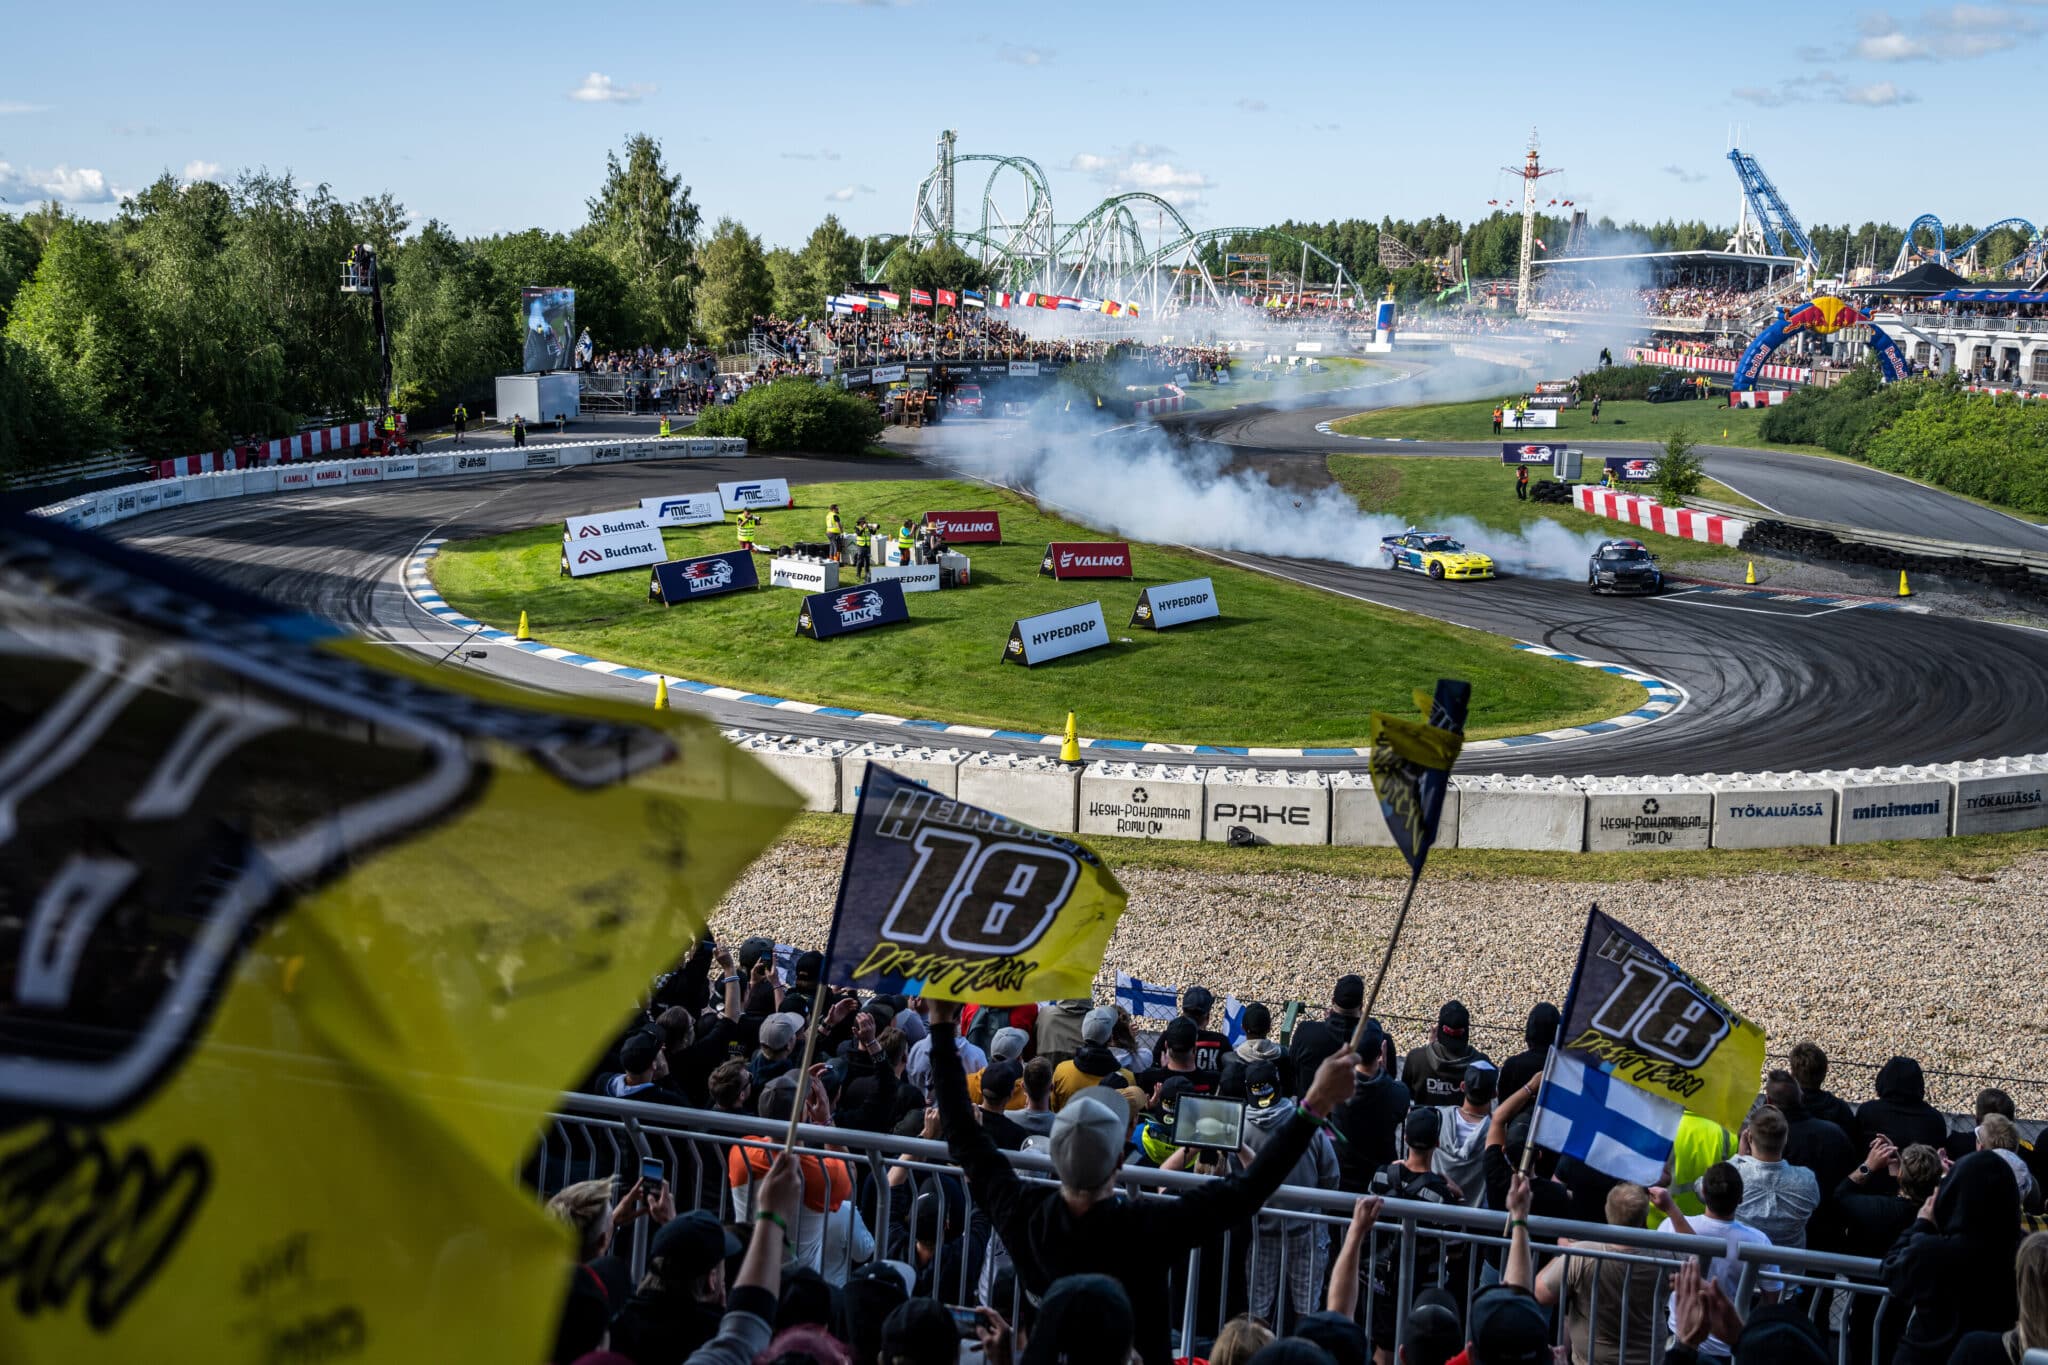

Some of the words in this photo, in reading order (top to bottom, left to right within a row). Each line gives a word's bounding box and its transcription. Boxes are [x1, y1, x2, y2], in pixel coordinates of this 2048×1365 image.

[283, 474, 308, 483] KAMULA
[316, 470, 342, 480] KAMULA
[353, 467, 379, 476] KAMULA
[602, 521, 650, 534] Budmat.
[604, 542, 657, 558] Budmat.
[773, 569, 822, 583] HYPEDROP
[1158, 593, 1209, 612] HYPEDROP
[1032, 619, 1096, 646] HYPEDROP
[1966, 789, 2041, 810] TYÖKALUÄSSÄ
[1213, 803, 1310, 826] PAKE
[1729, 802, 1823, 818] TYÖKALUÄSSÄ
[1852, 799, 1940, 819] minimani
[1117, 818, 1146, 834] ROMU
[882, 827, 1081, 956] 18
[1590, 958, 1731, 1069] 18
[1632, 1059, 1705, 1099] TEAM
